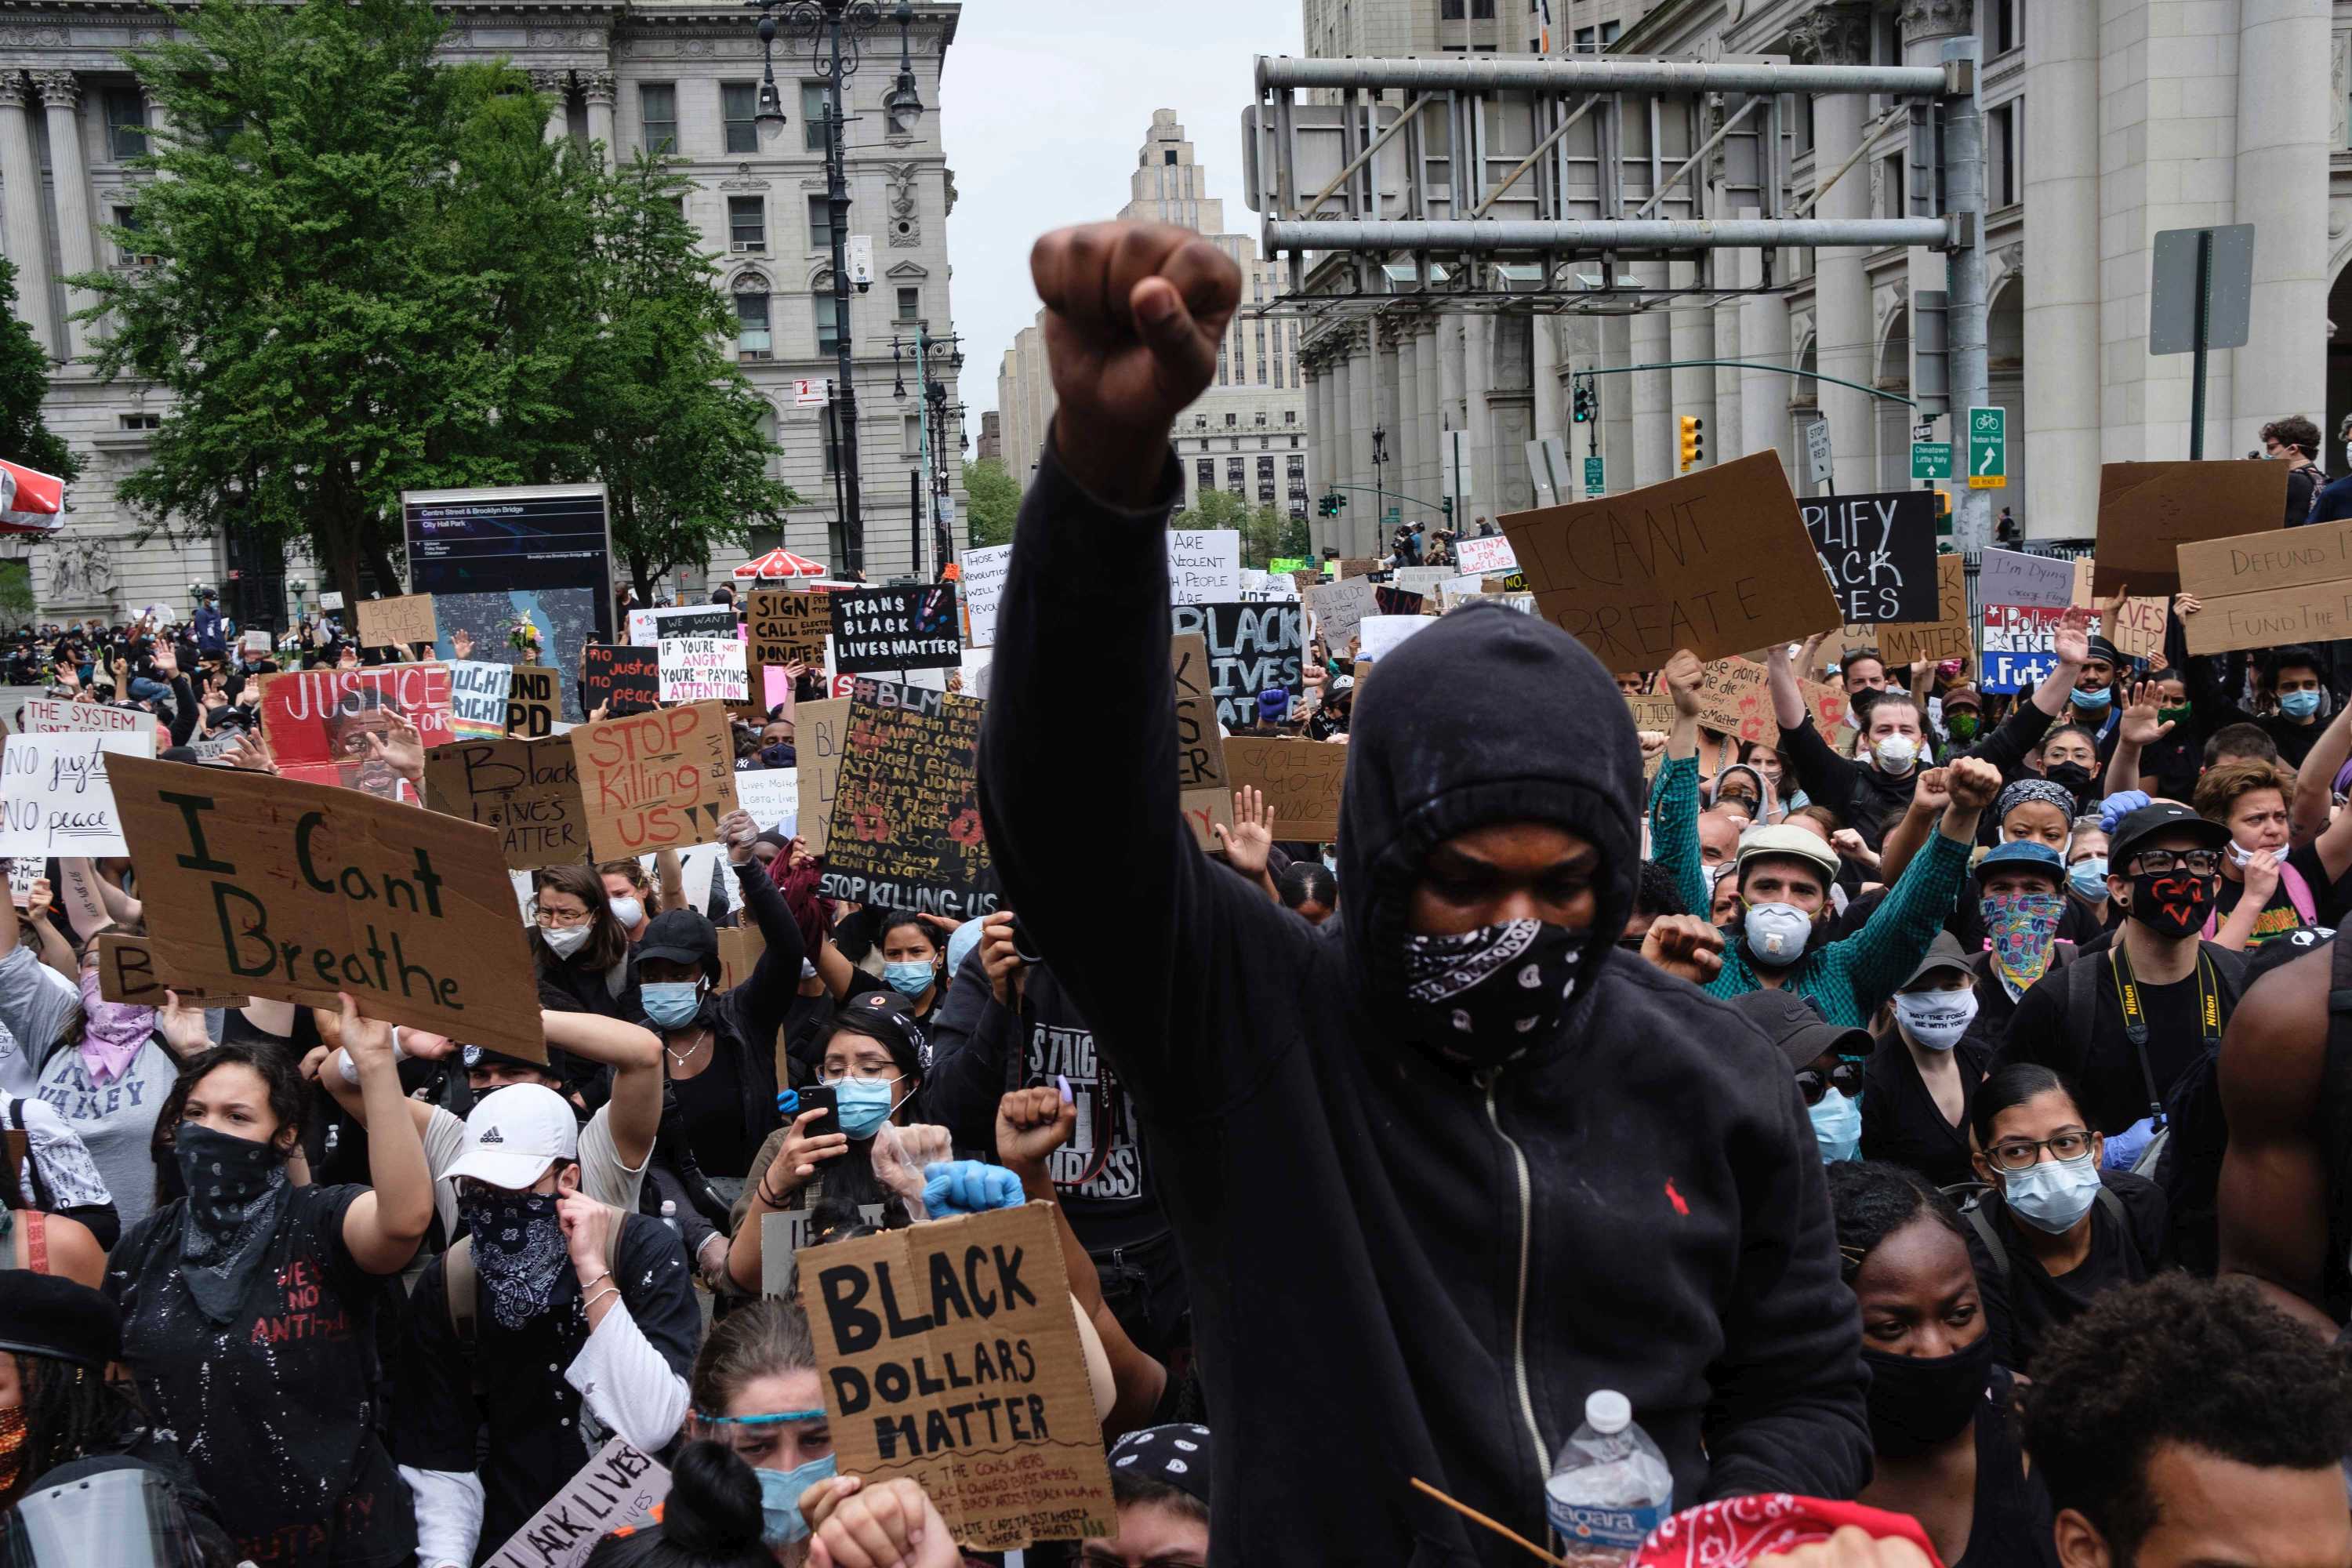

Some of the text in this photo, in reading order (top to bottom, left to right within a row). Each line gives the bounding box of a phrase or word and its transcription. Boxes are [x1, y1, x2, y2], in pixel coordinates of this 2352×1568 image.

[1809, 425, 1824, 438] STOP
[1813, 448, 1826, 459] RED
[472, 507, 502, 516] Brooklyn
[503, 506, 524, 514] Bridge
[1174, 532, 1205, 550] ARE
[1459, 537, 1507, 554] LATINX
[1506, 495, 1708, 595] I CANT
[963, 550, 995, 566] THOSE
[1478, 550, 1494, 560] FOR
[1488, 556, 1513, 569] LIVES
[2230, 548, 2326, 576] DEFUND
[1185, 571, 1229, 588] PEOPLE
[1505, 575, 1523, 589] NO
[1987, 557, 2067, 590] I'm Dying
[967, 586, 994, 597] WILL
[368, 598, 419, 617] BLACK
[757, 595, 809, 618] SIGN
[840, 597, 906, 618] TRANS
[667, 617, 684, 627] WE
[693, 615, 730, 625] WANT
[756, 622, 797, 638] CALL
[844, 617, 909, 637] BLACK
[2227, 604, 2334, 637] FUND THE
[367, 625, 434, 644] MATTER
[1887, 626, 1969, 660] MATTER
[662, 641, 672, 655] IF
[681, 640, 715, 654] YOU'RE
[757, 644, 812, 663] DONATE
[838, 638, 959, 659] LIVES MATTER
[681, 654, 725, 666] ANGRY
[590, 675, 611, 688] no
[661, 668, 695, 683] YOU'RE
[708, 668, 748, 684] PAYING
[1210, 656, 1301, 697] IVES
[1732, 666, 1762, 685] don't
[285, 666, 448, 720] JUSTICE
[670, 682, 741, 699] ATTENTION
[854, 679, 942, 717] #BLM
[28, 702, 136, 731] THE SYSTEM
[406, 712, 452, 732] FOR
[589, 706, 700, 768] STOP
[5, 746, 39, 775] NO
[463, 747, 579, 794] Black
[1, 800, 108, 848] NO peace
[503, 824, 577, 853] ATTER
[158, 789, 445, 919] I Cant
[818, 873, 866, 900] STOP
[966, 892, 999, 920] US
[210, 880, 465, 1011] Breathe
[2123, 984, 2139, 1016] Nikon
[2205, 994, 2217, 1027] Nikon
[1909, 1011, 1926, 1020] MAY
[818, 1243, 1037, 1356] BLACK
[829, 1338, 1036, 1417] DOLLARS
[873, 1393, 1049, 1460] MATTER
[940, 1453, 1045, 1481] THE CONSUMERS
[927, 1485, 967, 1502] LACK
[968, 1478, 1008, 1494] OWNED
[989, 1512, 1049, 1532] CAPITALIST
[1050, 1508, 1089, 1523] AMERICA
[488, 1504, 597, 1568] LACK
